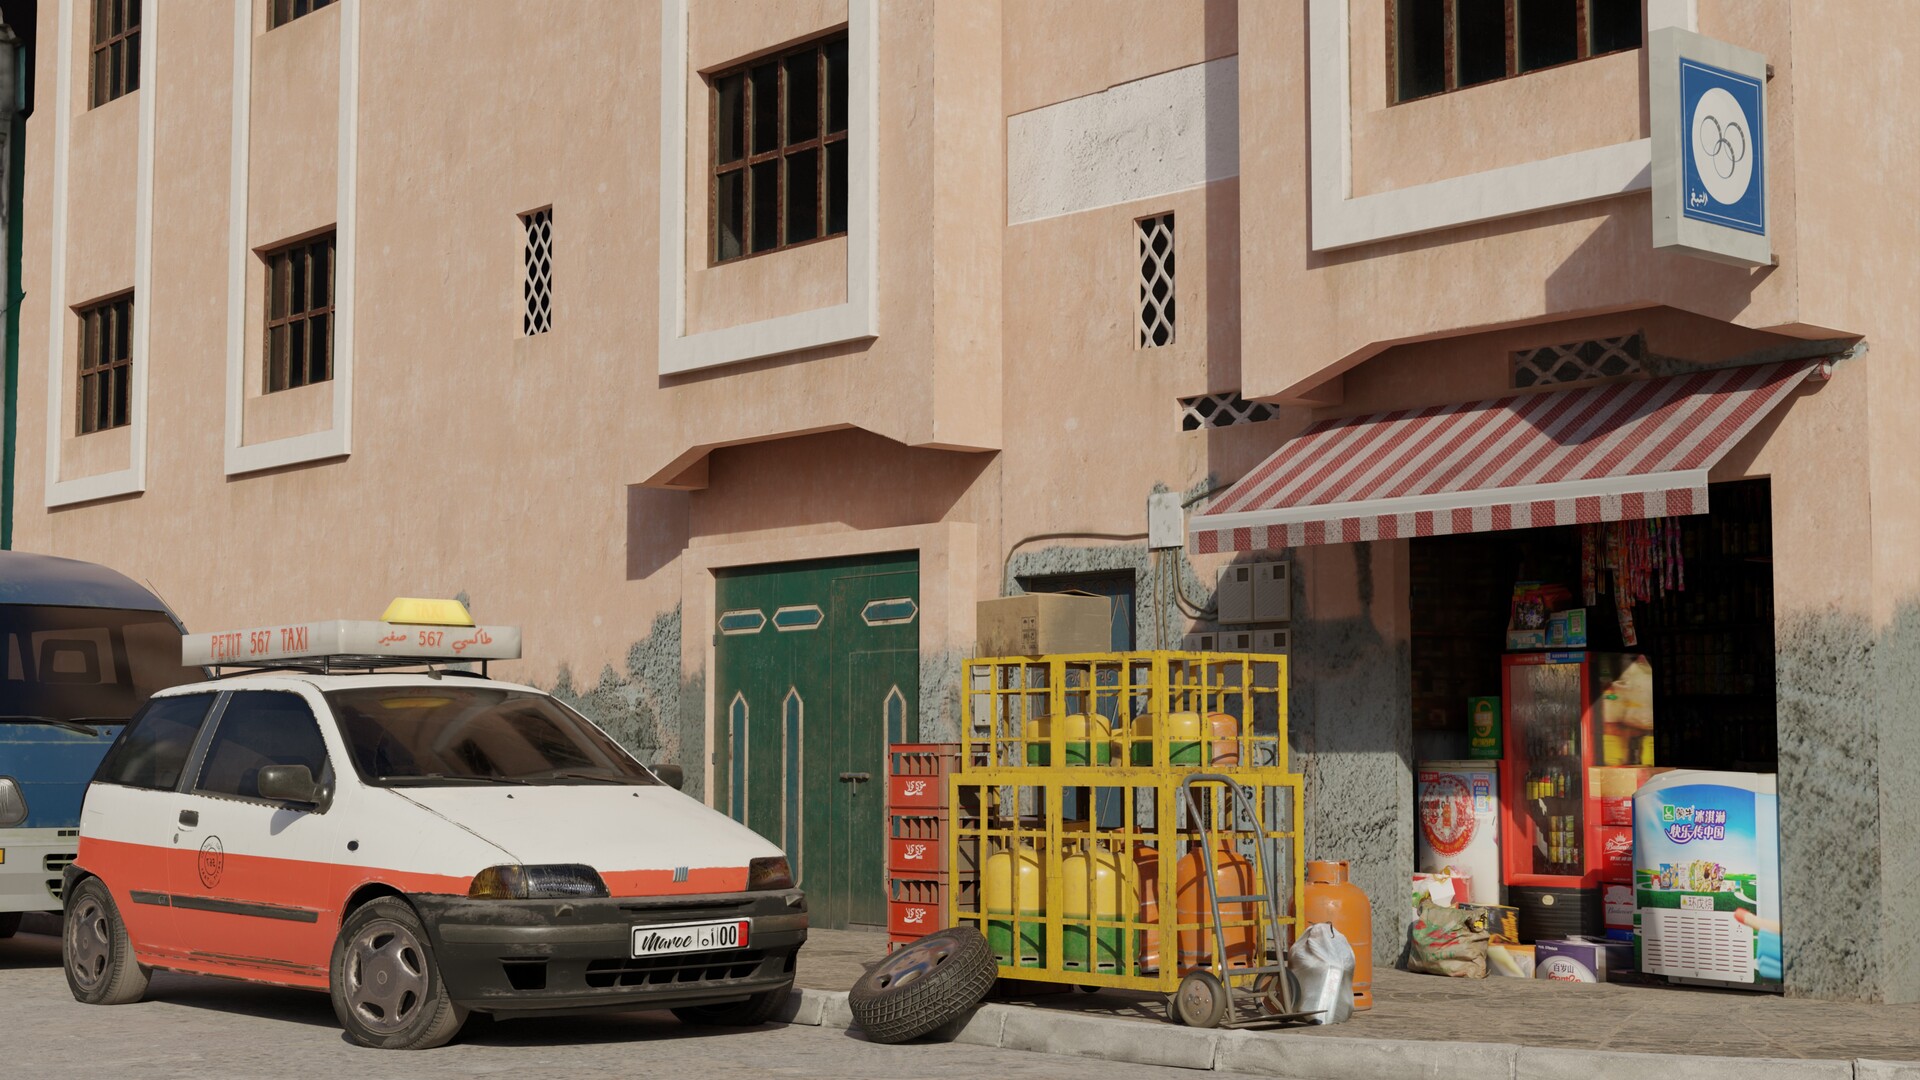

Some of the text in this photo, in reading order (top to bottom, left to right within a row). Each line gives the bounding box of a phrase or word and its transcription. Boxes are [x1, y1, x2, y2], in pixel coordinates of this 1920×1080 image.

[210, 626, 309, 658] PETIT 567 TAXI
[378, 628, 493, 653] طاكسي 567 صغير
[1694, 810, 1726, 824] 冰淇淋
[641, 932, 692, 952] Maroc
[1553, 963, 1574, 974] 百岁山
